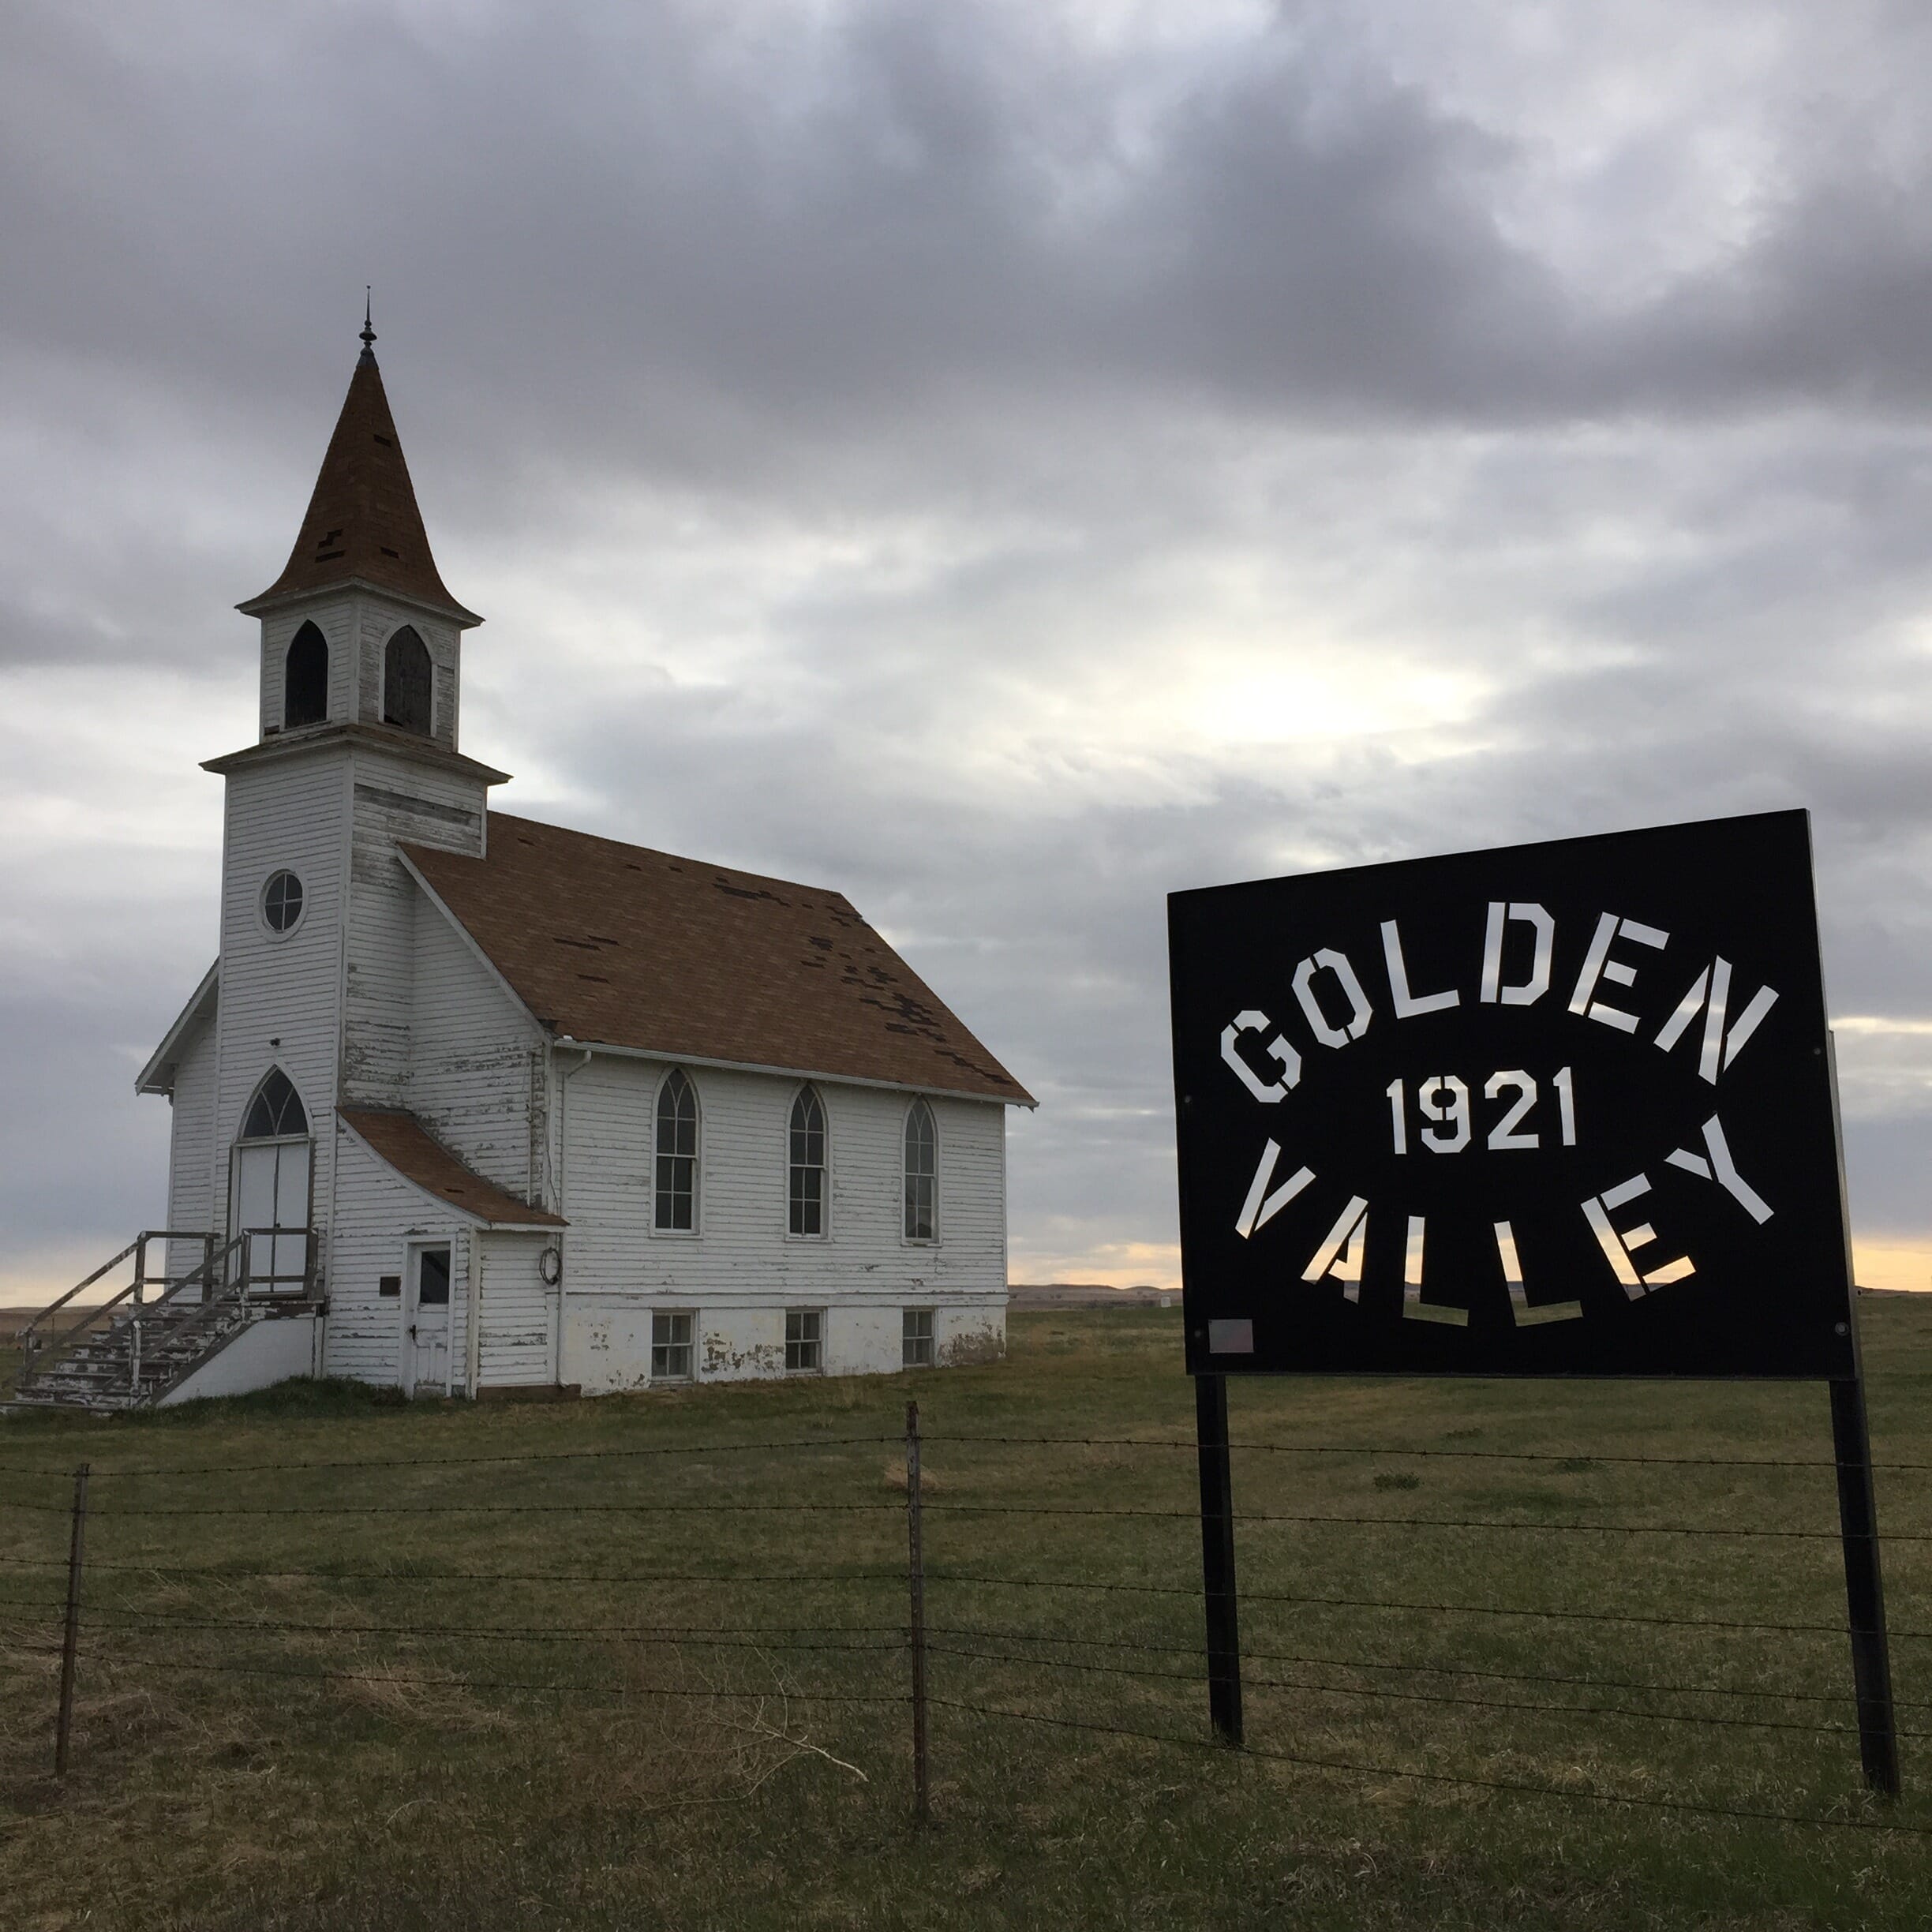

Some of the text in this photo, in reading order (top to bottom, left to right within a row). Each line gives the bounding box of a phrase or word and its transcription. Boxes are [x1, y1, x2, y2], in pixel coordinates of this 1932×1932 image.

[1220, 901, 1780, 1103] GOLDEN
[1386, 1066, 1577, 1155] 1921
[1234, 1113, 1776, 1327] VALLEY
